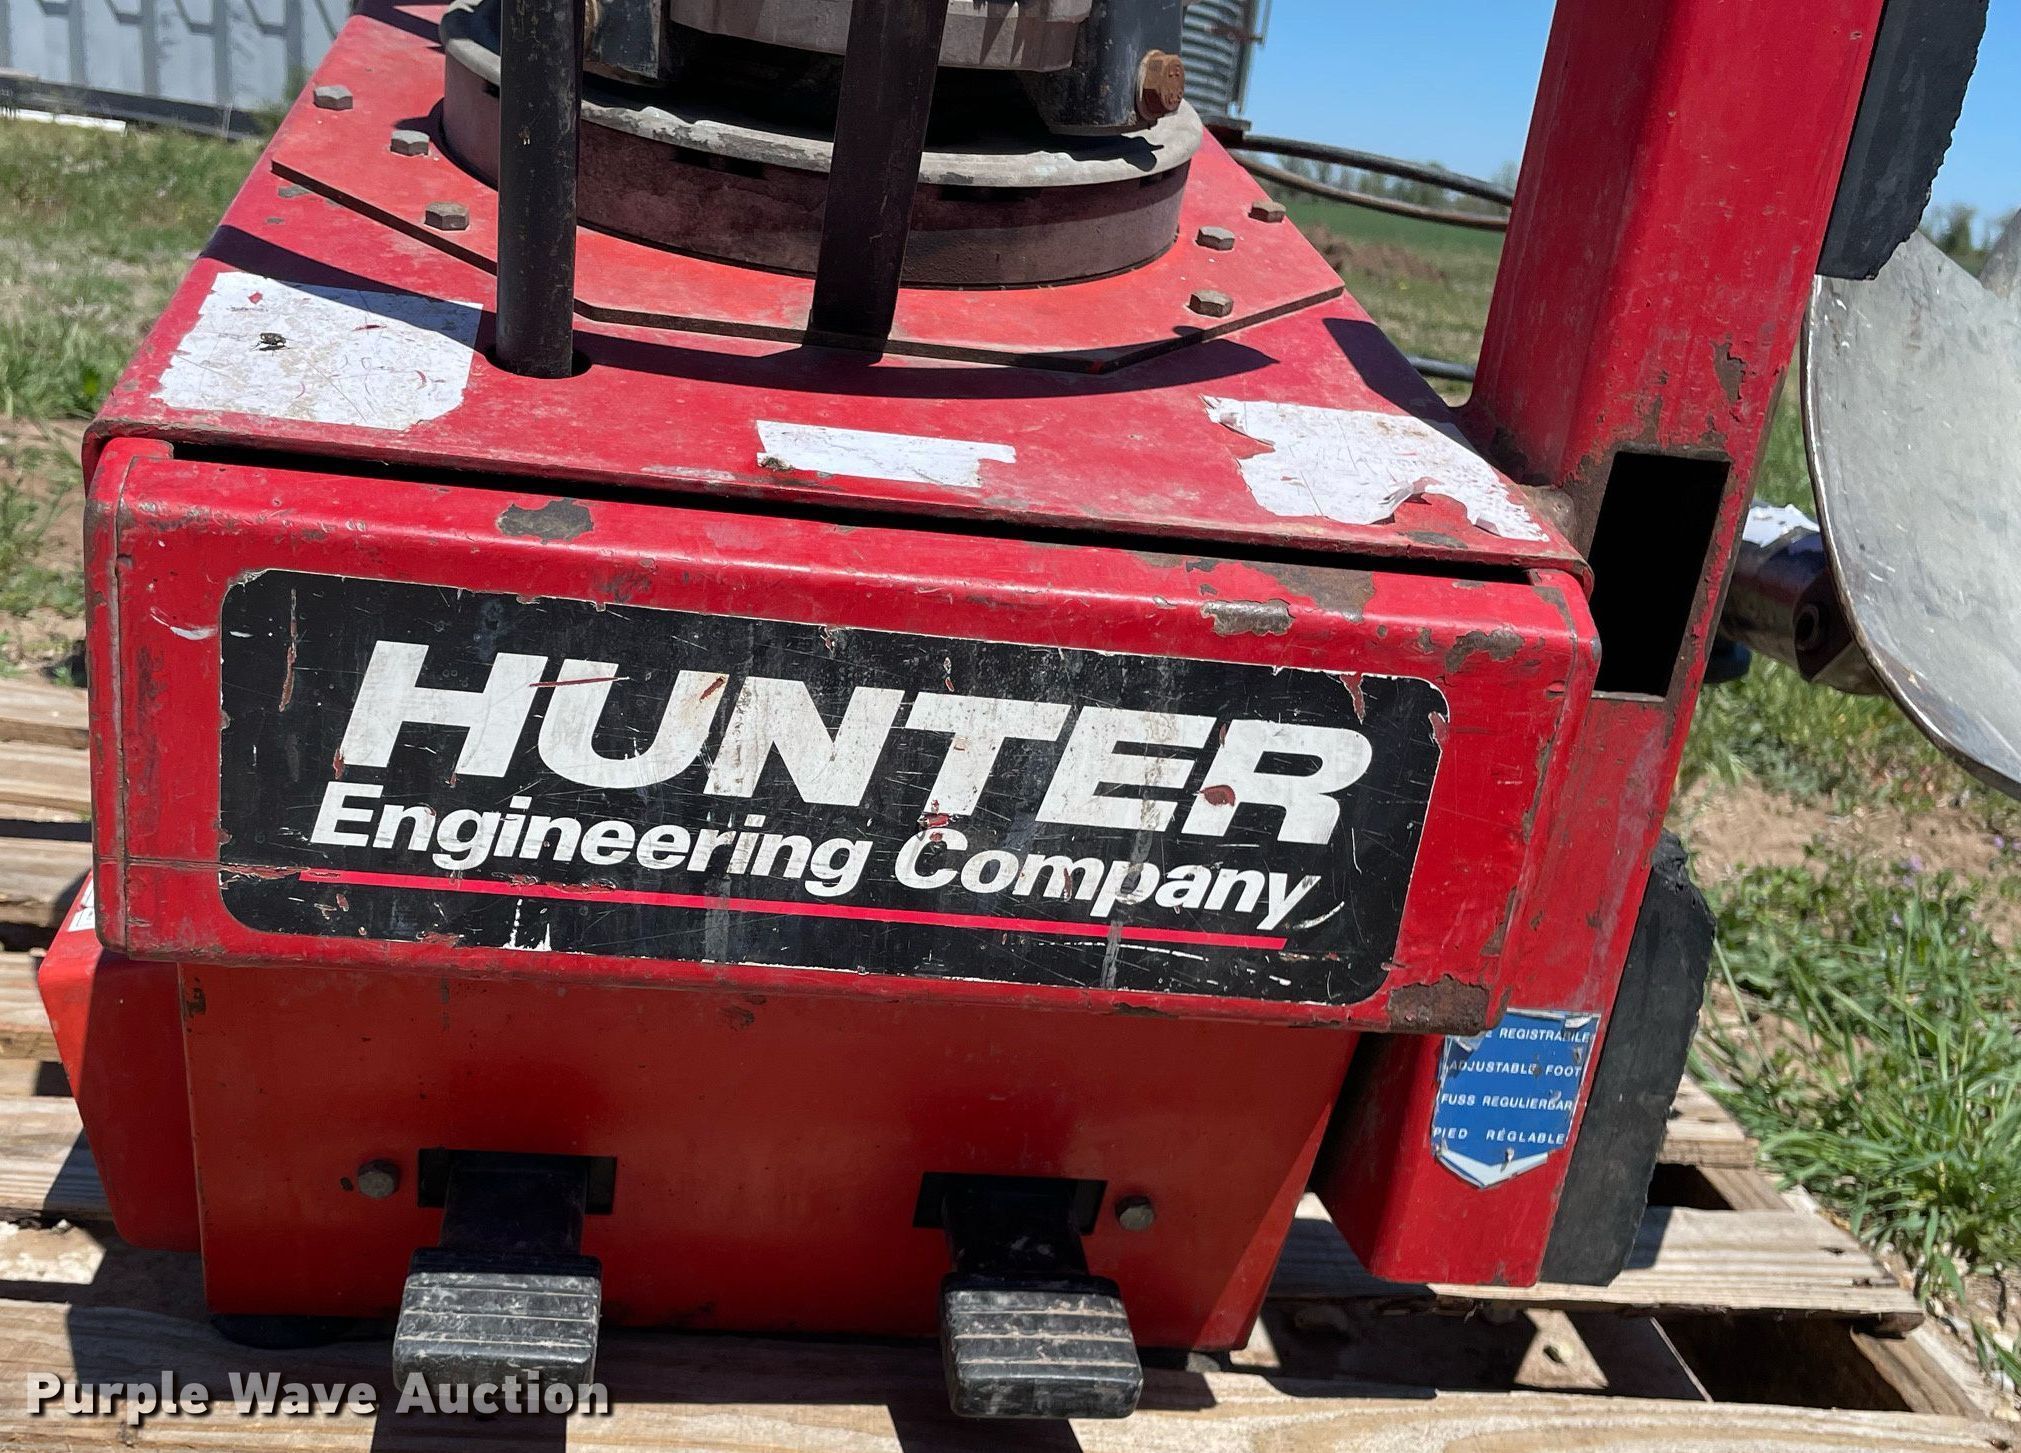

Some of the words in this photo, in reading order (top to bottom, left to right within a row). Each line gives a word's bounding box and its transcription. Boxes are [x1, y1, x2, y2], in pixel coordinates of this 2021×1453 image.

[342, 640, 1372, 845] HUNTER
[310, 781, 873, 898] Engineering
[894, 827, 1322, 930] Company
[1449, 1060, 1537, 1075] ADJUSTABLE
[1545, 1064, 1582, 1077] FOOT
[1441, 1093, 1475, 1106] FUSS
[1482, 1095, 1573, 1111] REGULIERBAR
[1433, 1126, 1468, 1139] PIED
[1486, 1128, 1566, 1145] RÉGLABLE
